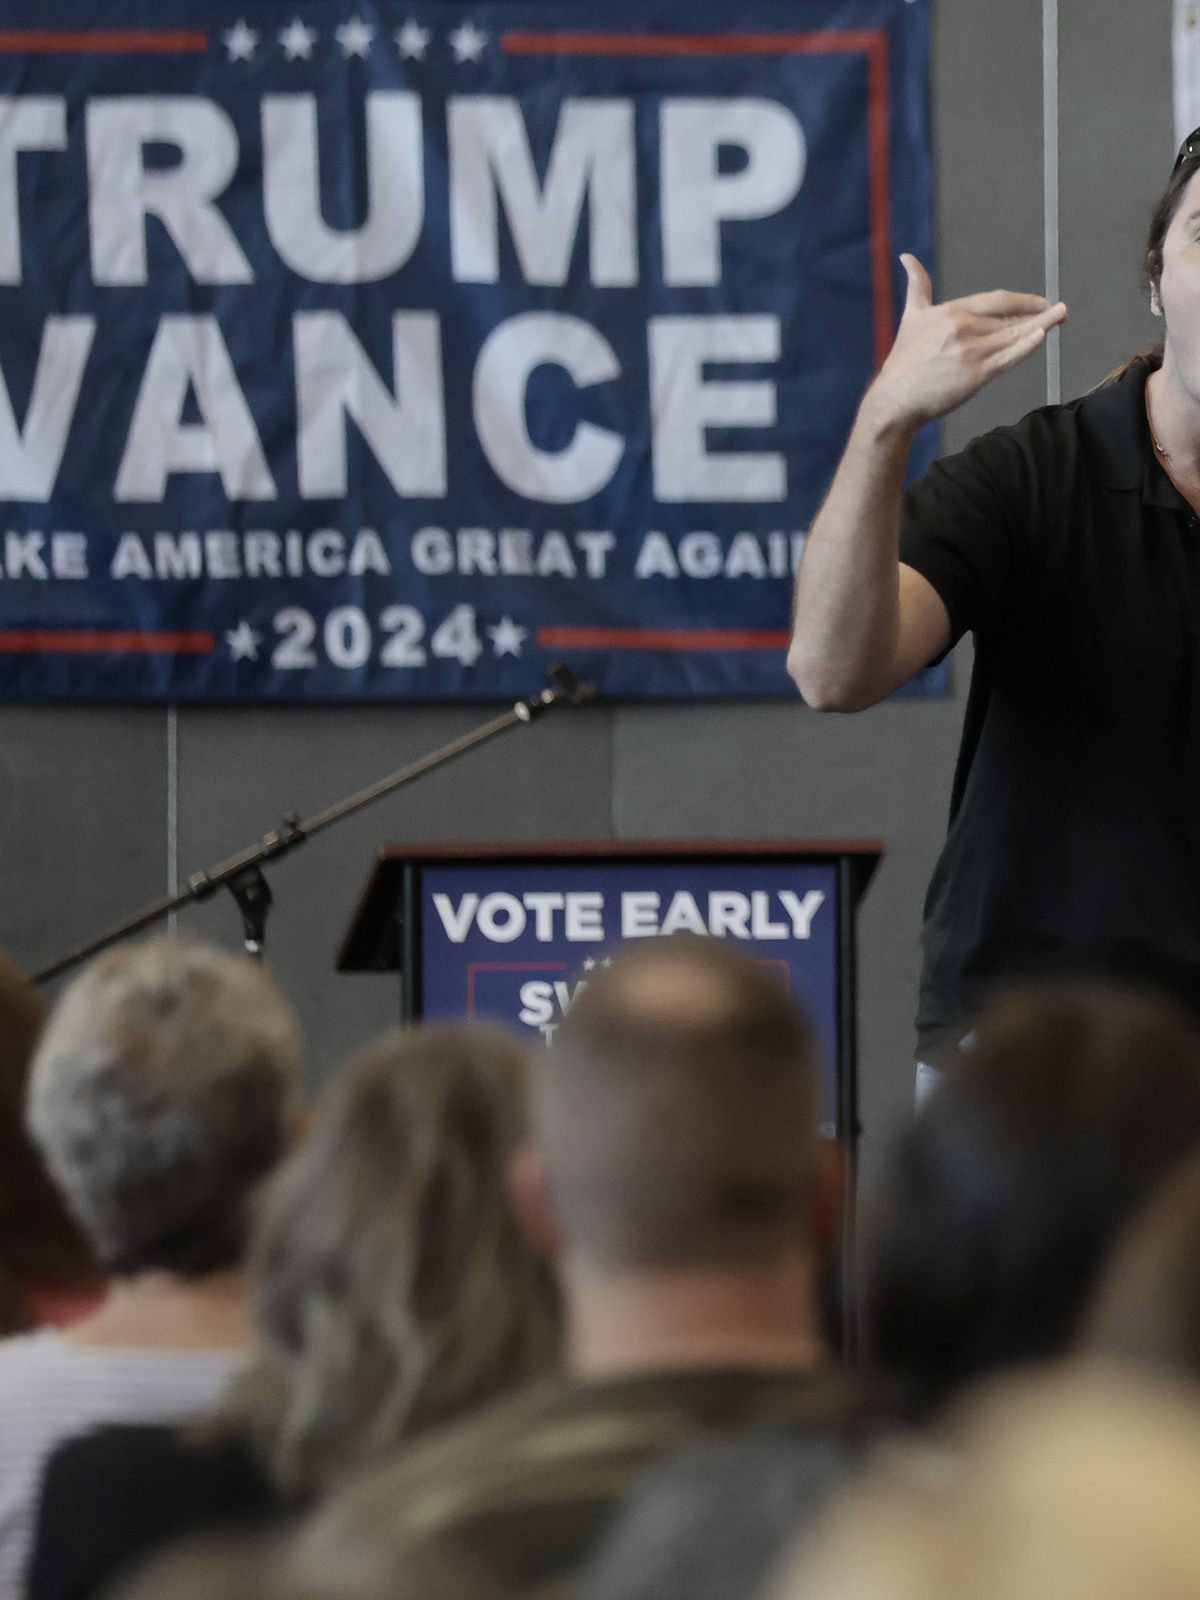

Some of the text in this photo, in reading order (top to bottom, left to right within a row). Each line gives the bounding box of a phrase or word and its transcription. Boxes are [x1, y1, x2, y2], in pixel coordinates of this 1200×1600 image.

[0, 310, 788, 504] VANCE
[0, 530, 90, 580] KE
[110, 528, 392, 580] AMERICA
[410, 527, 617, 578] GREAT
[270, 604, 484, 669] 2024
[432, 889, 826, 943] VOTE EARLY
